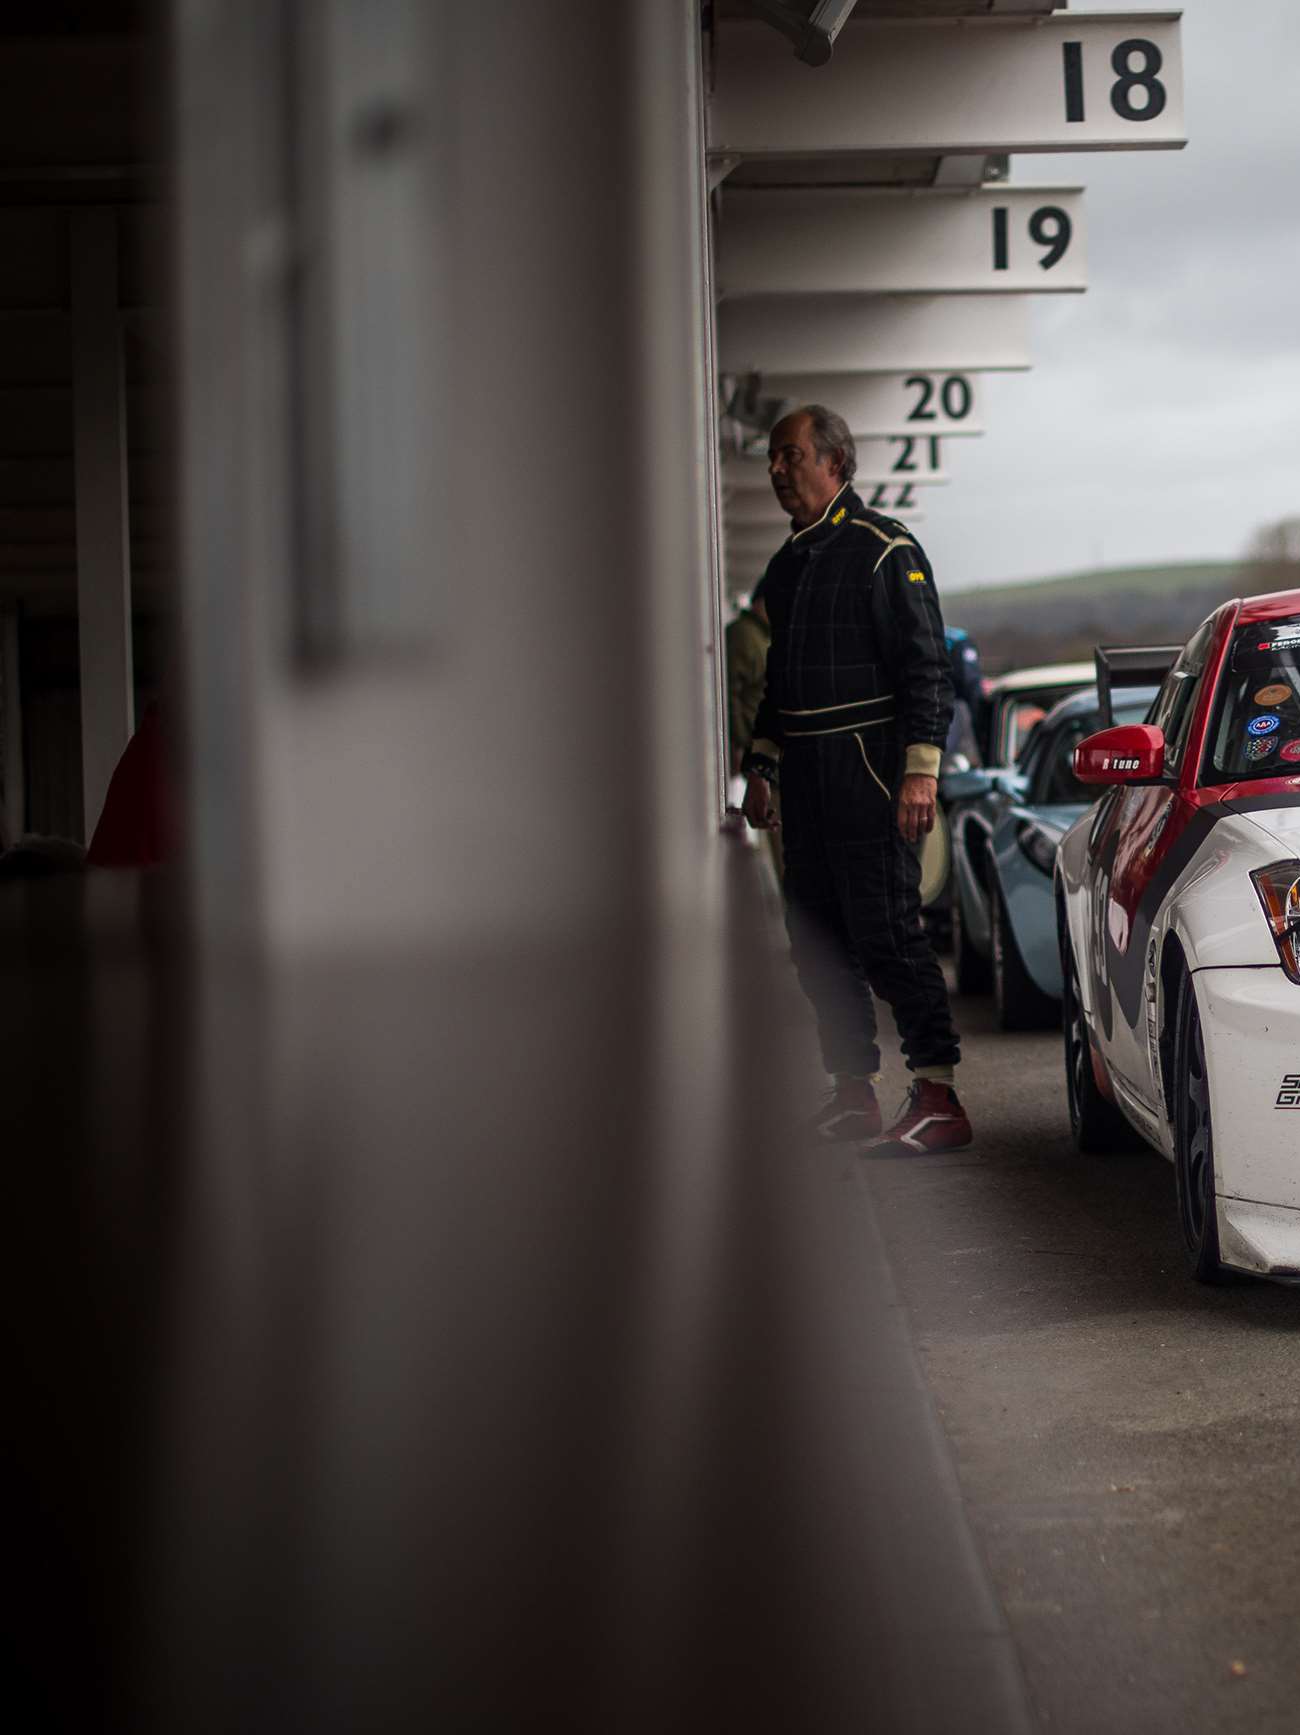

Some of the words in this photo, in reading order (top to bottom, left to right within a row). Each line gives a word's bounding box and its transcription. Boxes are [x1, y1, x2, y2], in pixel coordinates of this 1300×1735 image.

[1062, 39, 1167, 122] 18
[991, 206, 1072, 271] 19
[904, 376, 972, 421] 20
[888, 434, 940, 472] 21
[1113, 759, 1140, 770] tune
